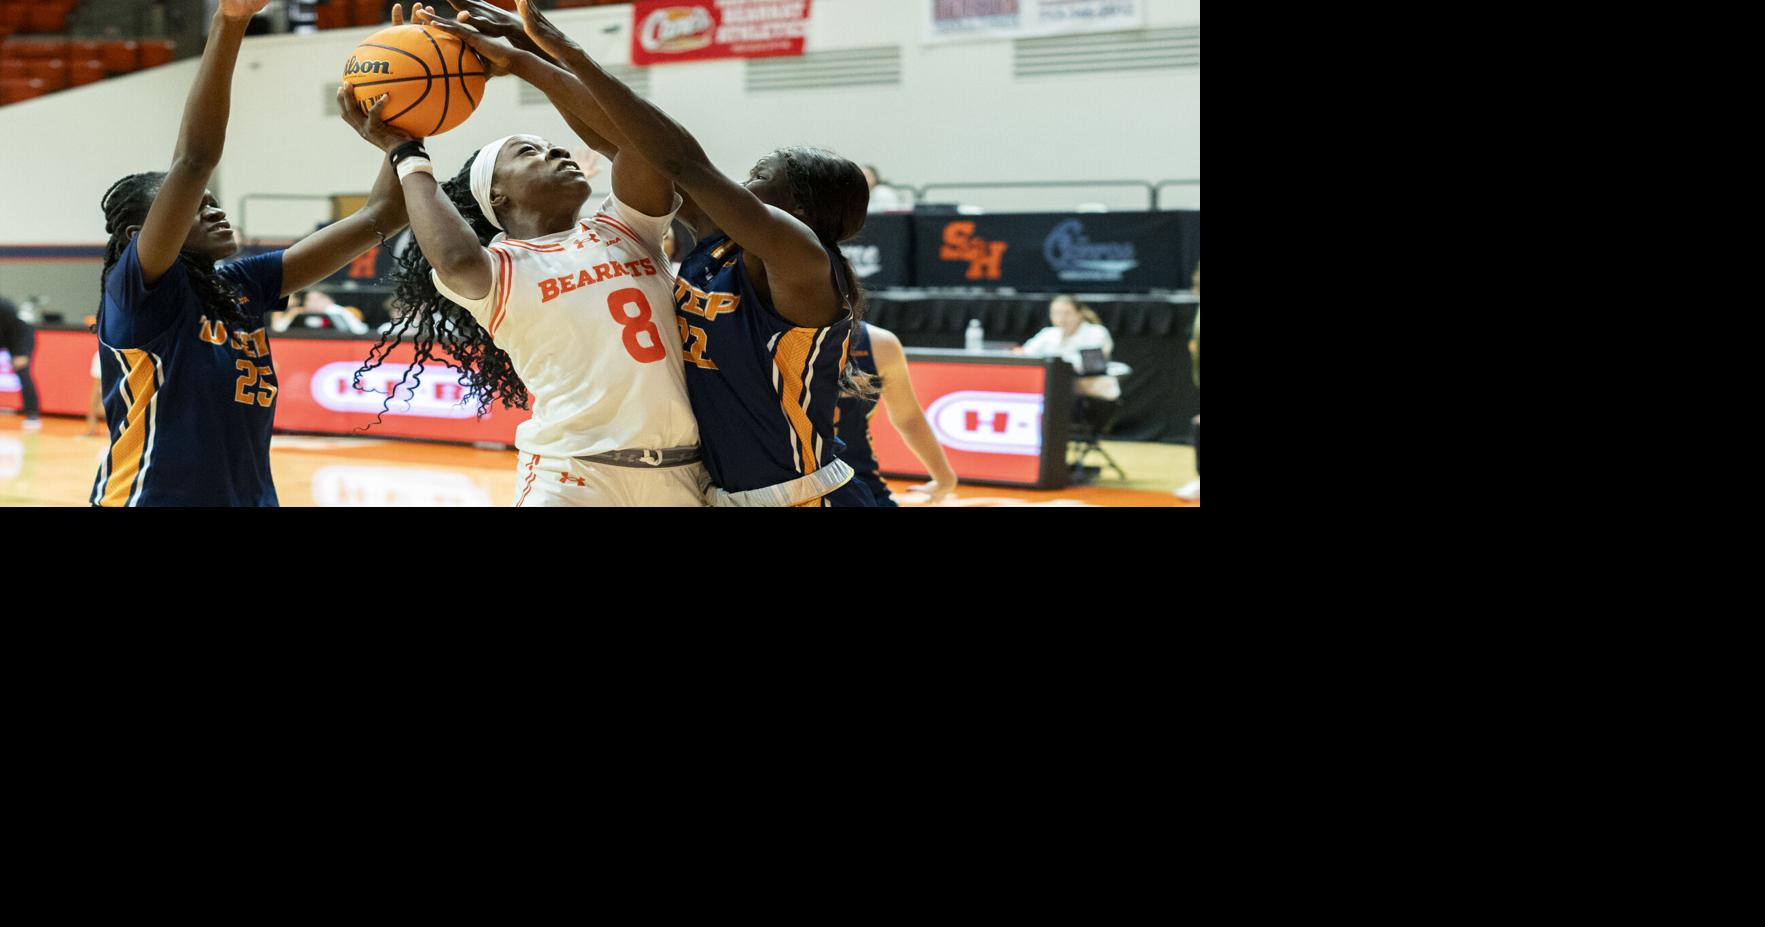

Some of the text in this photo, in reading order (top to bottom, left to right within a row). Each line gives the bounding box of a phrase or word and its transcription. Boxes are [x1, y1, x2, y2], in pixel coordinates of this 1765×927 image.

[537, 257, 657, 304] BEARKTS
[673, 275, 740, 321] TEP
[607, 287, 666, 364] 8
[234, 358, 278, 408] 25
